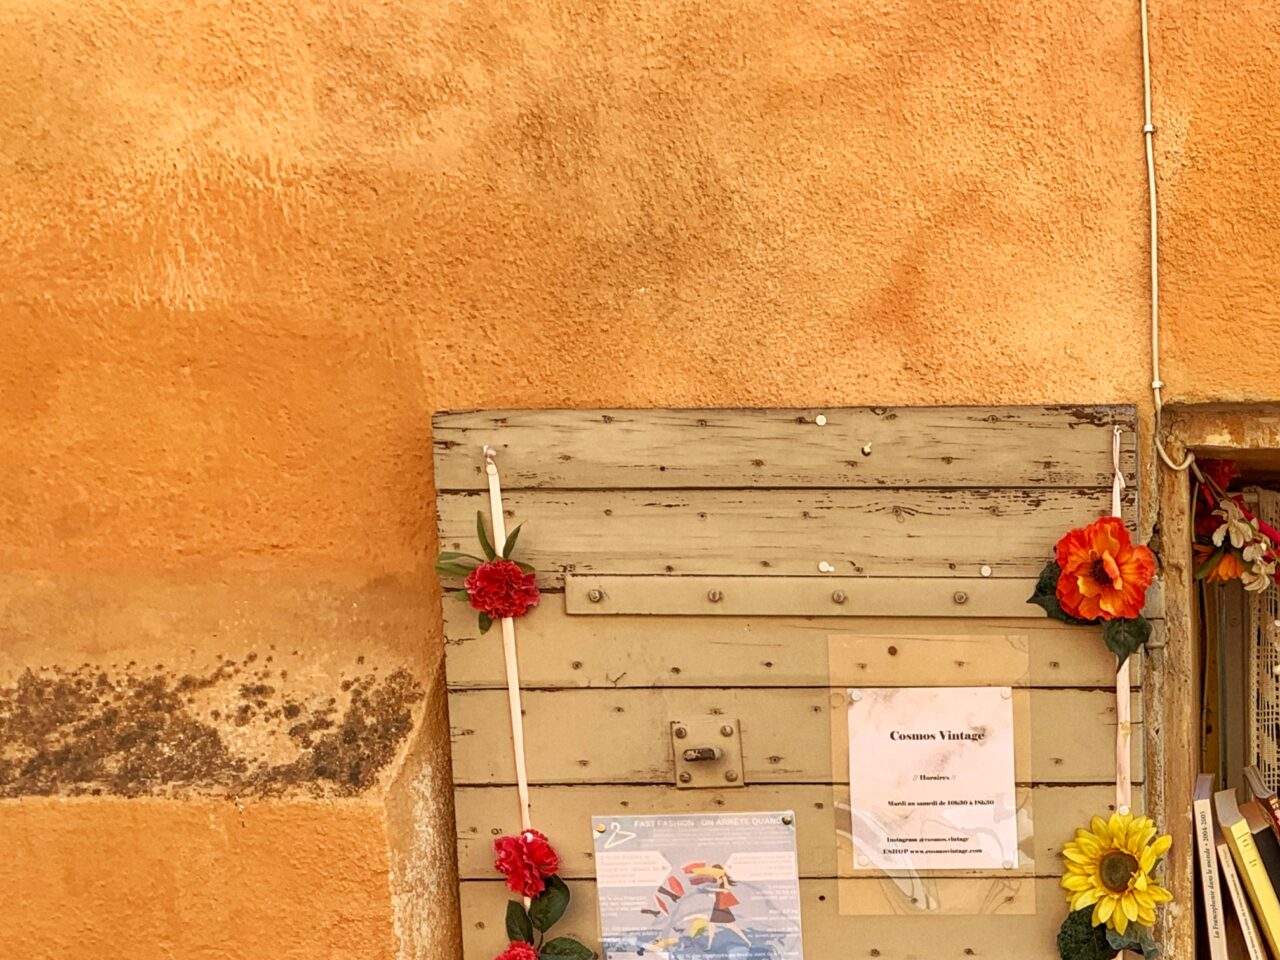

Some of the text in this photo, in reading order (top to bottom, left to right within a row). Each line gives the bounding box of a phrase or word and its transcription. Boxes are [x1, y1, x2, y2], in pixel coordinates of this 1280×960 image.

[889, 730, 985, 742] Cosmos Vintage
[656, 819, 695, 827] FASHION
[700, 818, 714, 827] ON
[1203, 847, 1212, 868] monde
[1209, 889, 1219, 930] Francophonie
[1213, 930, 1220, 938] La
